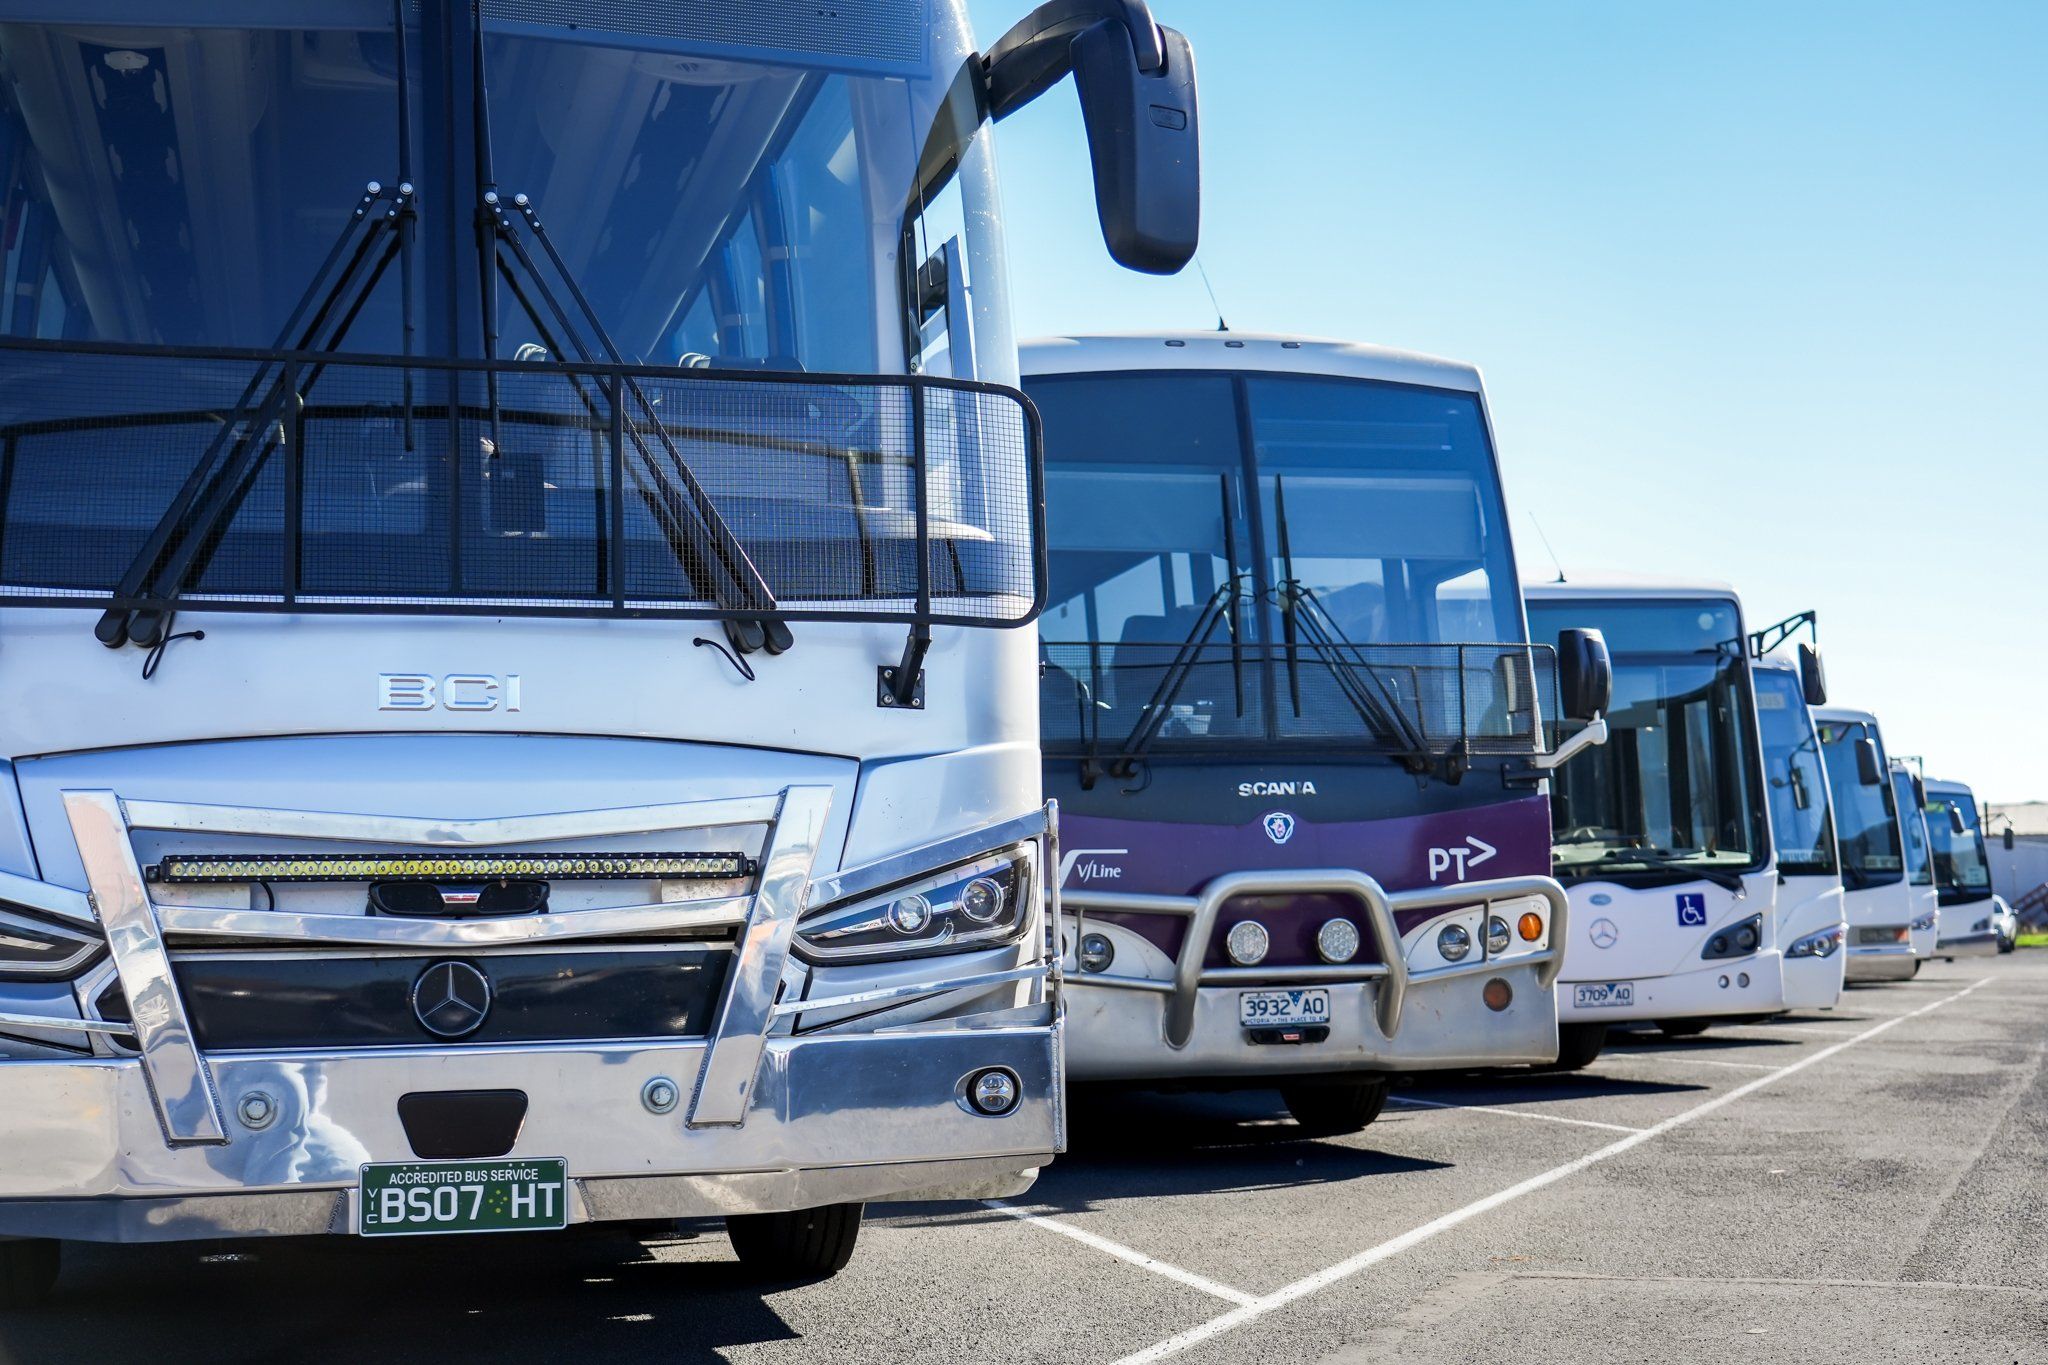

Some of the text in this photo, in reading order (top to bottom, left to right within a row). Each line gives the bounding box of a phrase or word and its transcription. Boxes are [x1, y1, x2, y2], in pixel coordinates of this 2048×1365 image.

[378, 673, 521, 712] BCI
[1077, 860, 1122, 883] V/Line
[1578, 989, 1608, 1001] 3709
[1245, 999, 1291, 1017] 3932
[389, 1169, 539, 1184] ACCREDITED BUS SERVICE
[511, 1182, 561, 1218] HT
